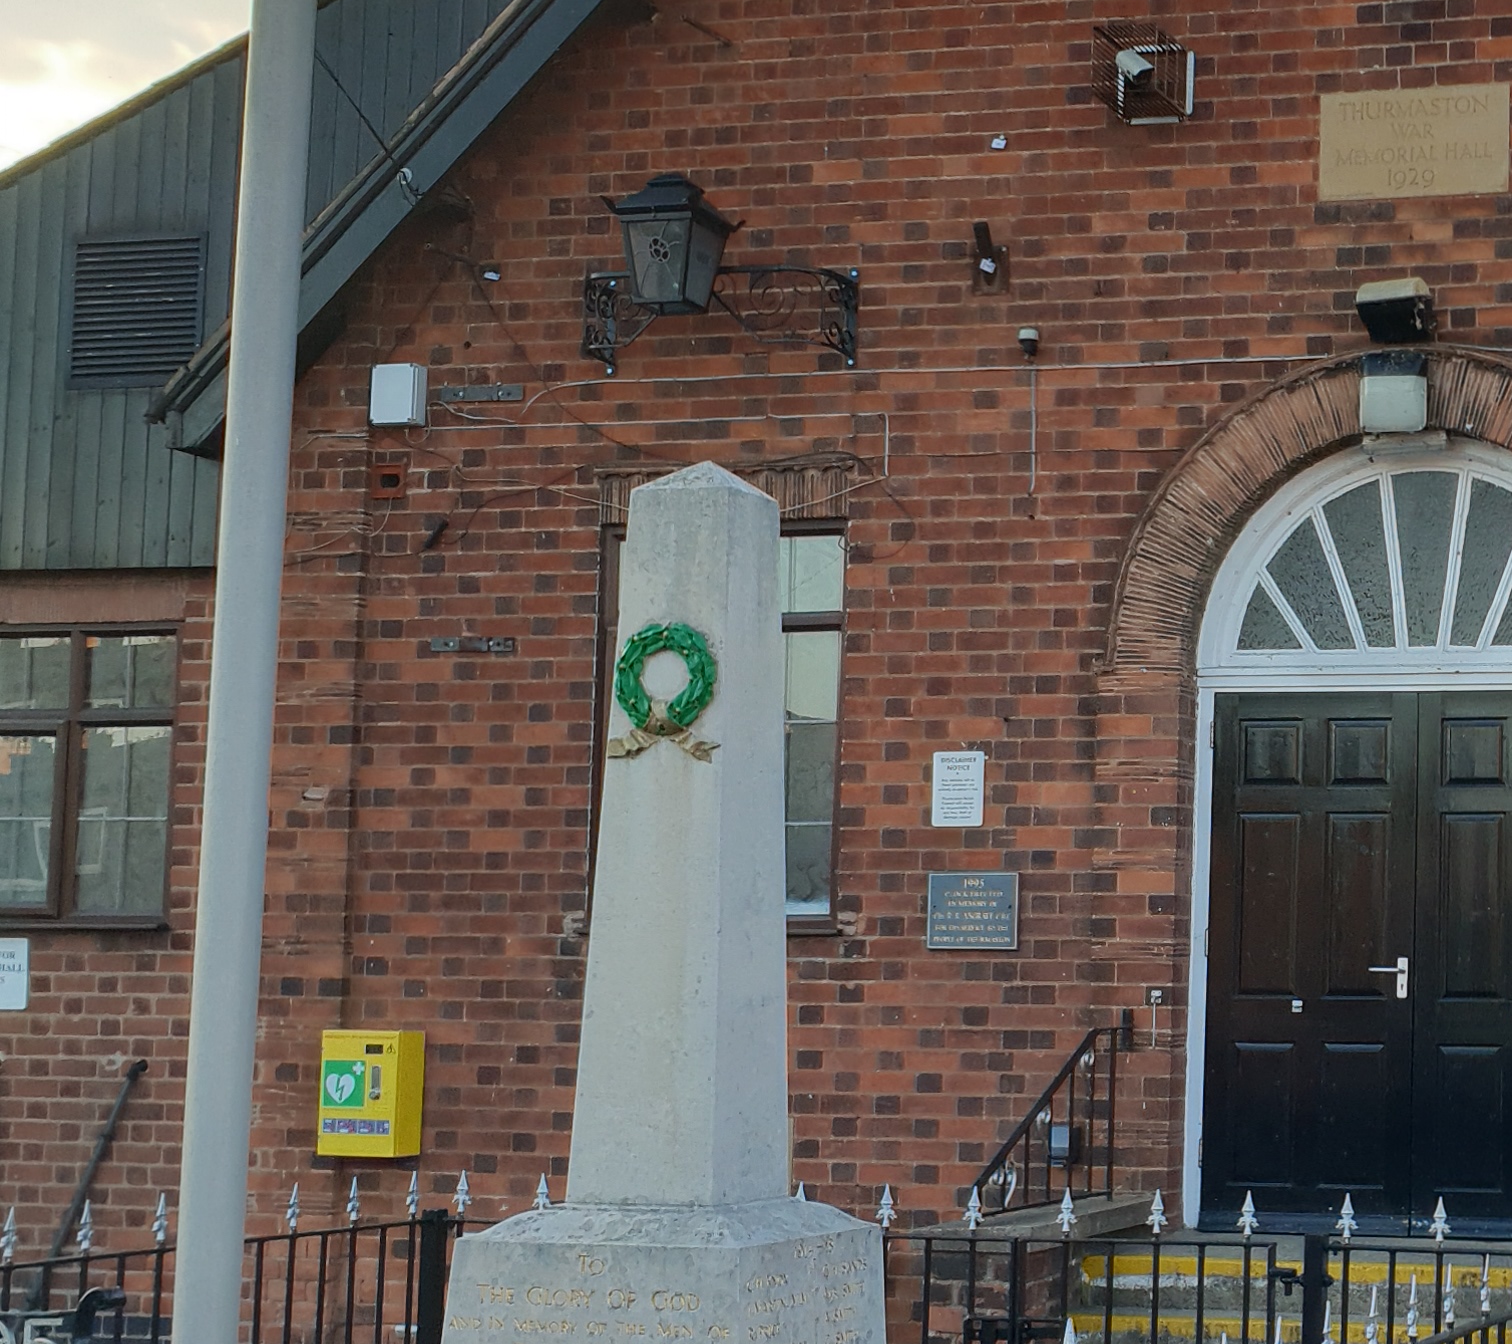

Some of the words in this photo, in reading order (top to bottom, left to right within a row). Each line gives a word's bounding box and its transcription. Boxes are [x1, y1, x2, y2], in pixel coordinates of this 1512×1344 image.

[1339, 96, 1489, 120] THURMASTON
[1391, 123, 1434, 140] WAR
[1336, 146, 1438, 166] MEMORIAL
[1445, 142, 1492, 160] HALL
[1387, 168, 1436, 189] 1929
[477, 1284, 515, 1305] THE
[526, 1285, 595, 1309] GLORY
[607, 1289, 637, 1310] OF
[651, 1290, 700, 1312] GOD
[449, 1316, 481, 1331] AND
[488, 1317, 504, 1331] IN
[513, 1319, 577, 1335] MEMORY
[586, 1321, 607, 1336] OF
[616, 1321, 645, 1336] THE
[657, 1323, 692, 1339] MEN
[708, 1325, 730, 1340] OF
